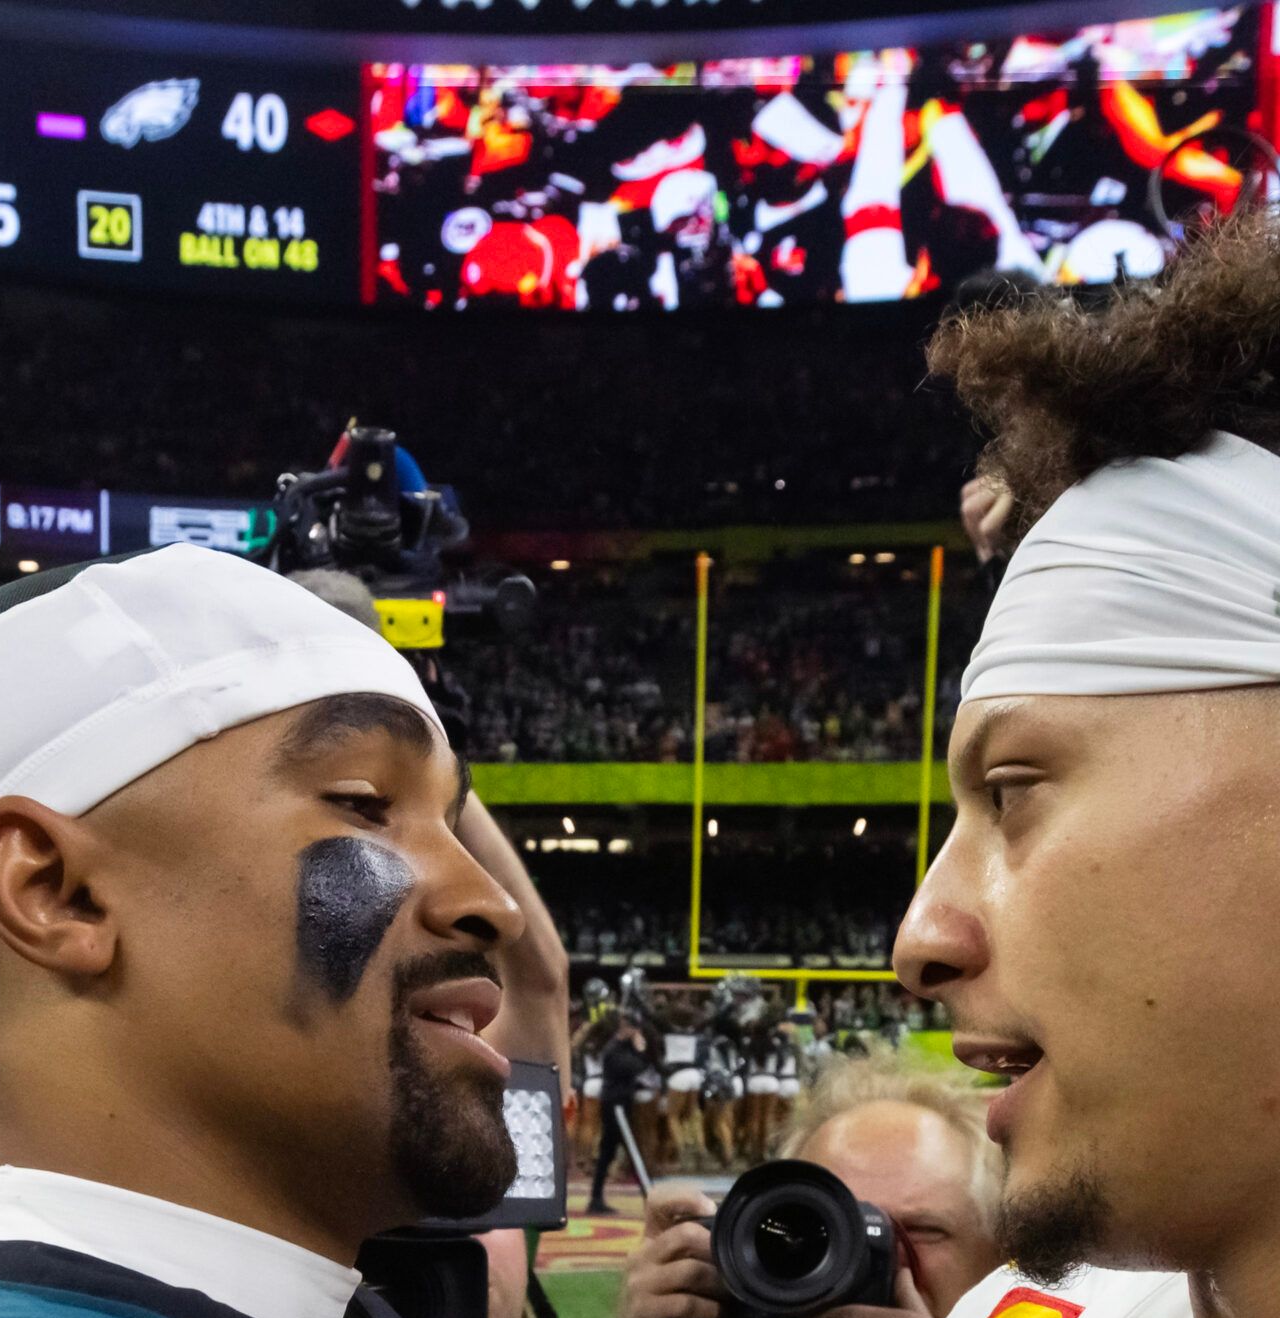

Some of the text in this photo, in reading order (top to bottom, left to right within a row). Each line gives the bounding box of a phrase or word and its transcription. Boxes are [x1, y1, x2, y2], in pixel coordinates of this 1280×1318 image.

[221, 92, 288, 153] 40
[89, 205, 131, 246] 20
[179, 232, 239, 268] BALL
[243, 236, 280, 270] ON
